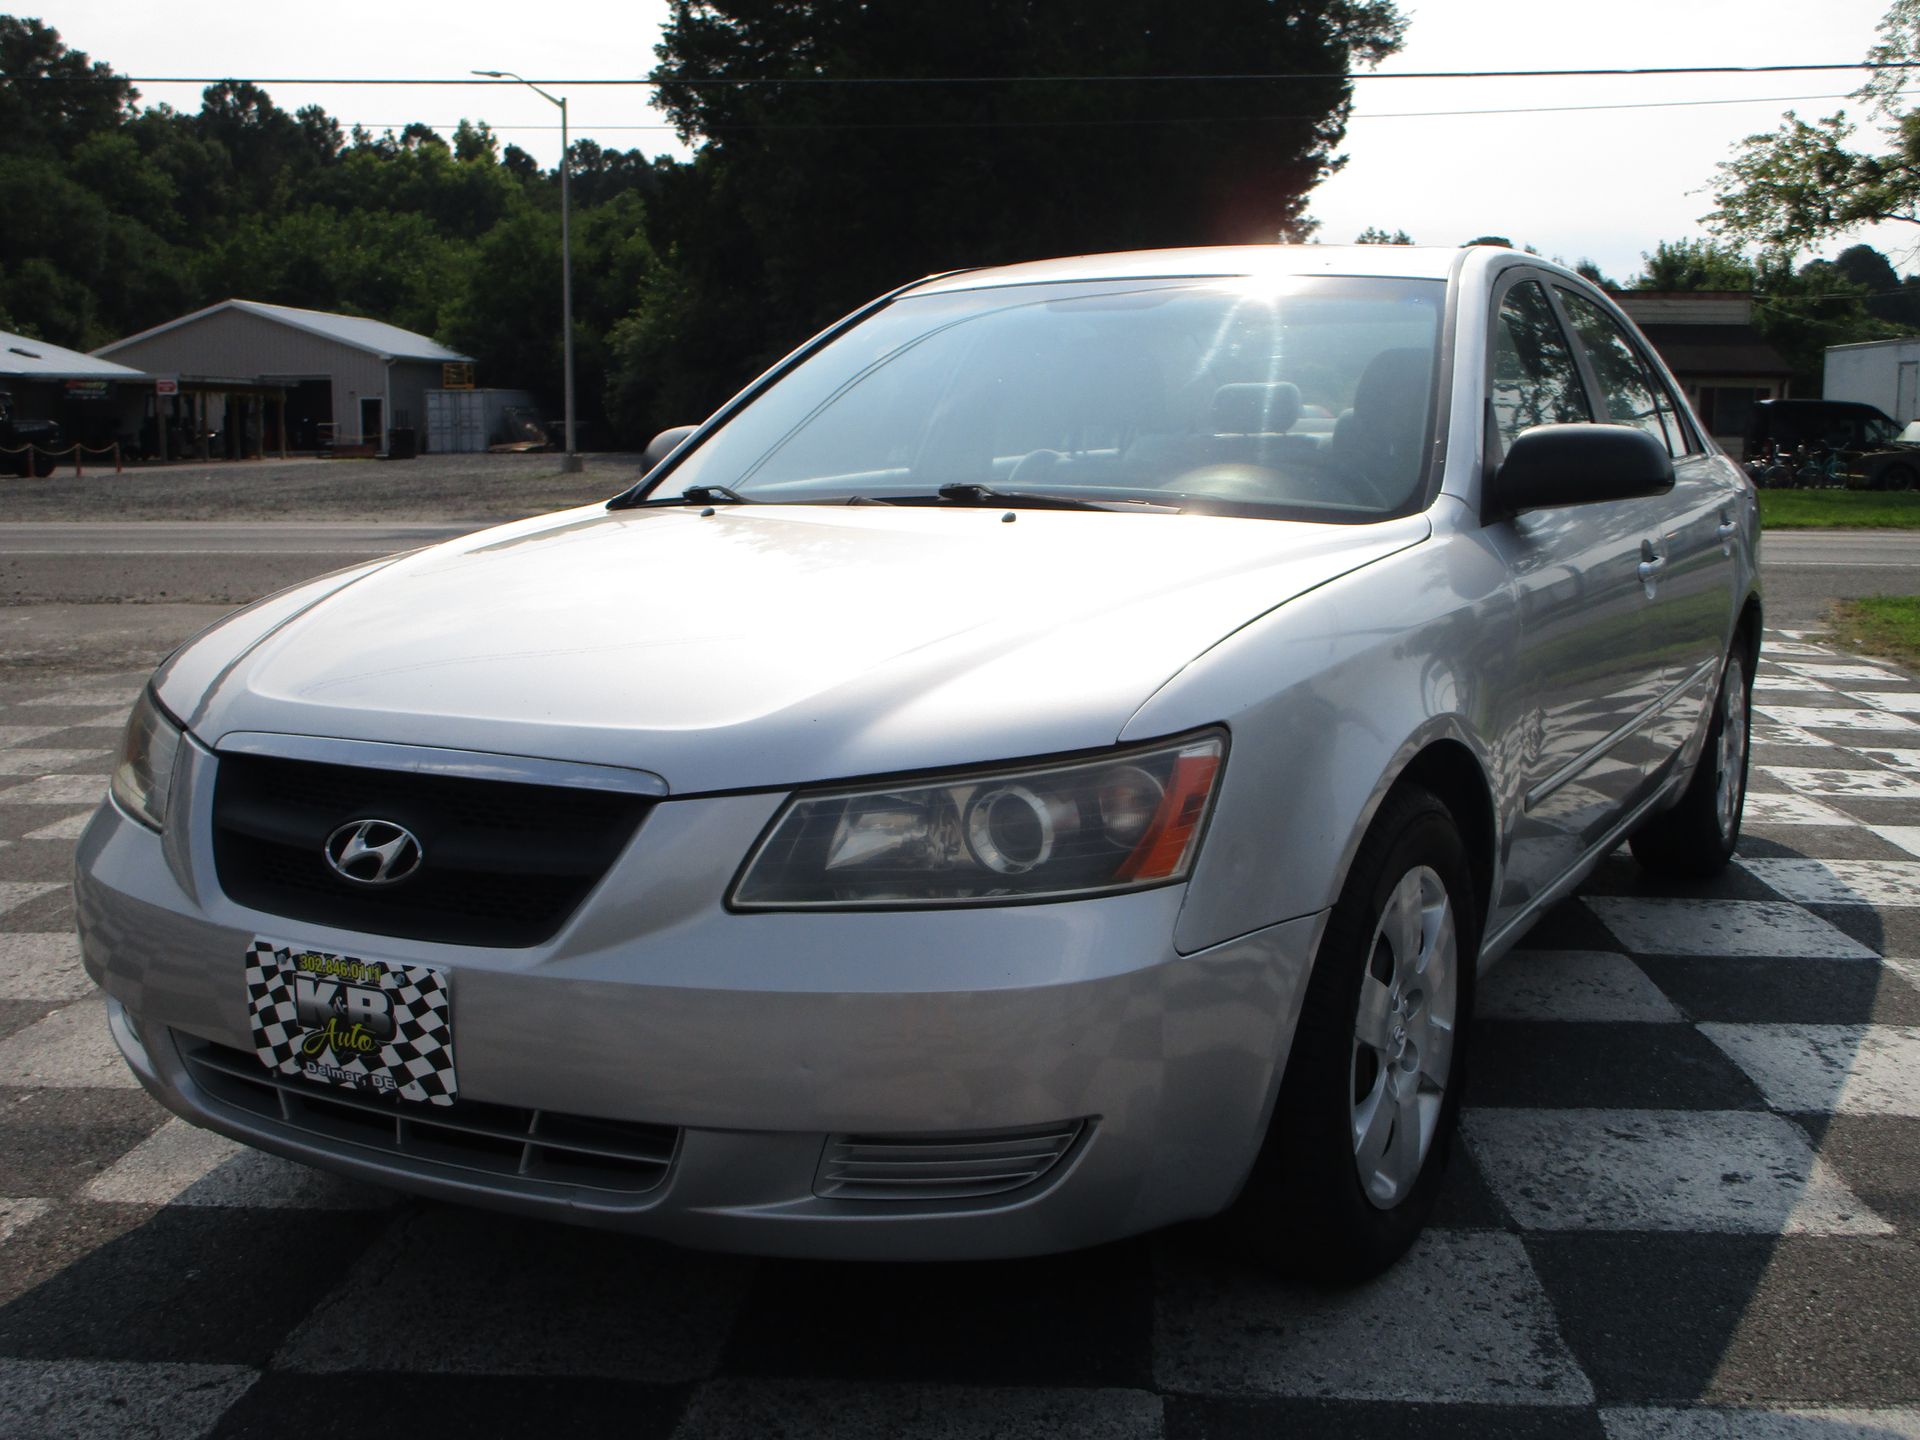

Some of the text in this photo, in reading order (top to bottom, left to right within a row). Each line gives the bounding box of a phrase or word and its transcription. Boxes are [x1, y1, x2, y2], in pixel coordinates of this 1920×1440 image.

[301, 954, 381, 982] 302.846.0111
[304, 1017, 375, 1054] Auto
[306, 1061, 394, 1089] Delmar, DE
